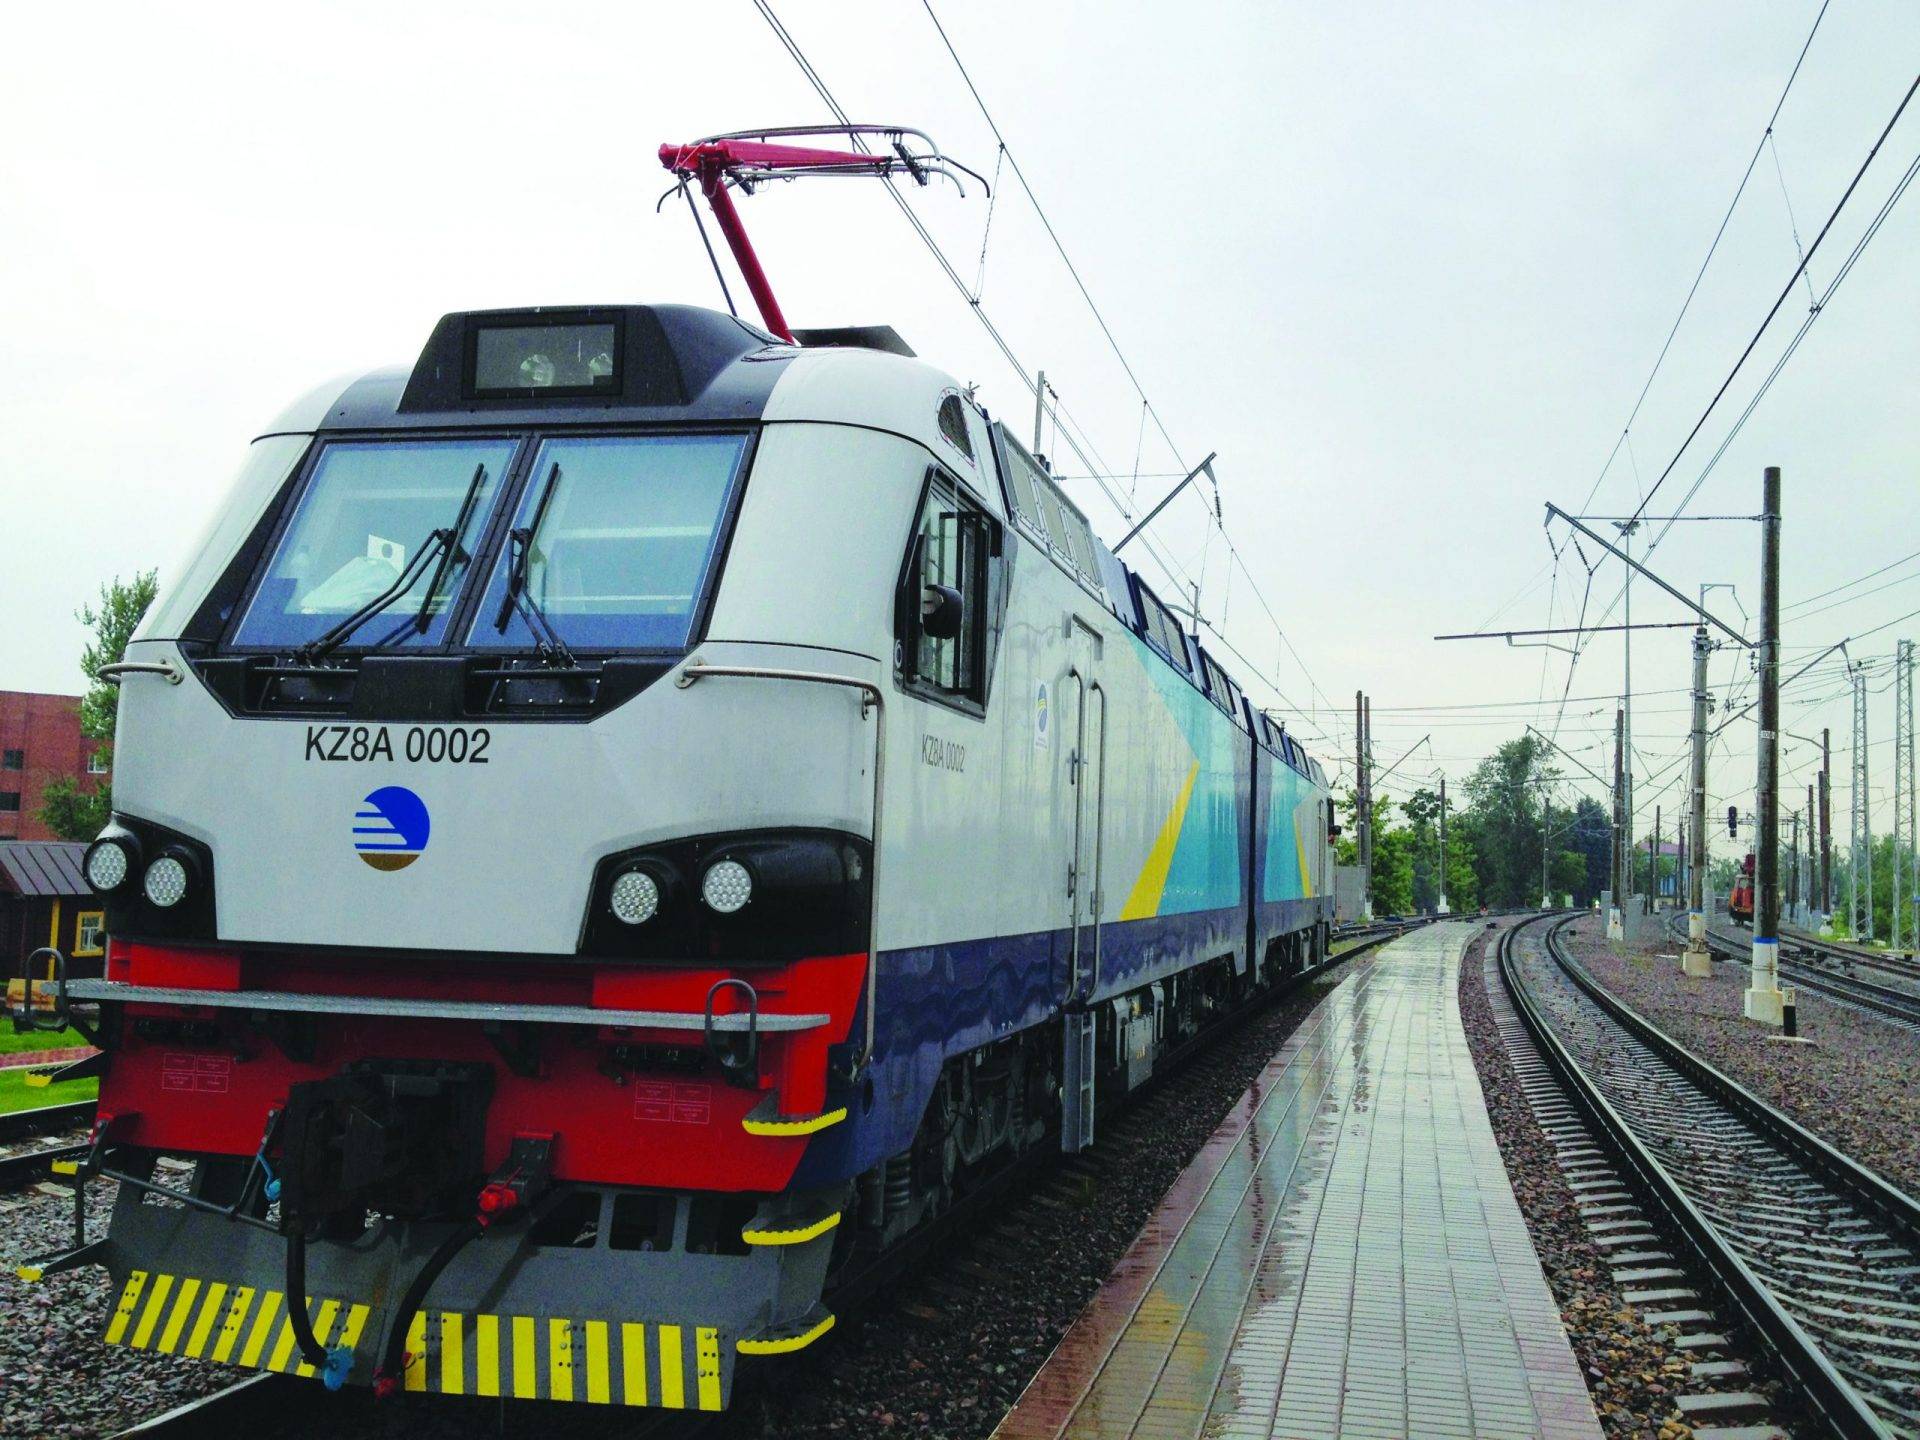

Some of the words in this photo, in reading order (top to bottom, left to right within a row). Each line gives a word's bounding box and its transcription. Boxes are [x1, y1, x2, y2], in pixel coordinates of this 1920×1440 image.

[305, 726, 394, 762] KZ8A
[405, 727, 491, 763] 0002
[921, 733, 944, 768] KZ8A
[946, 741, 965, 773] 0002
